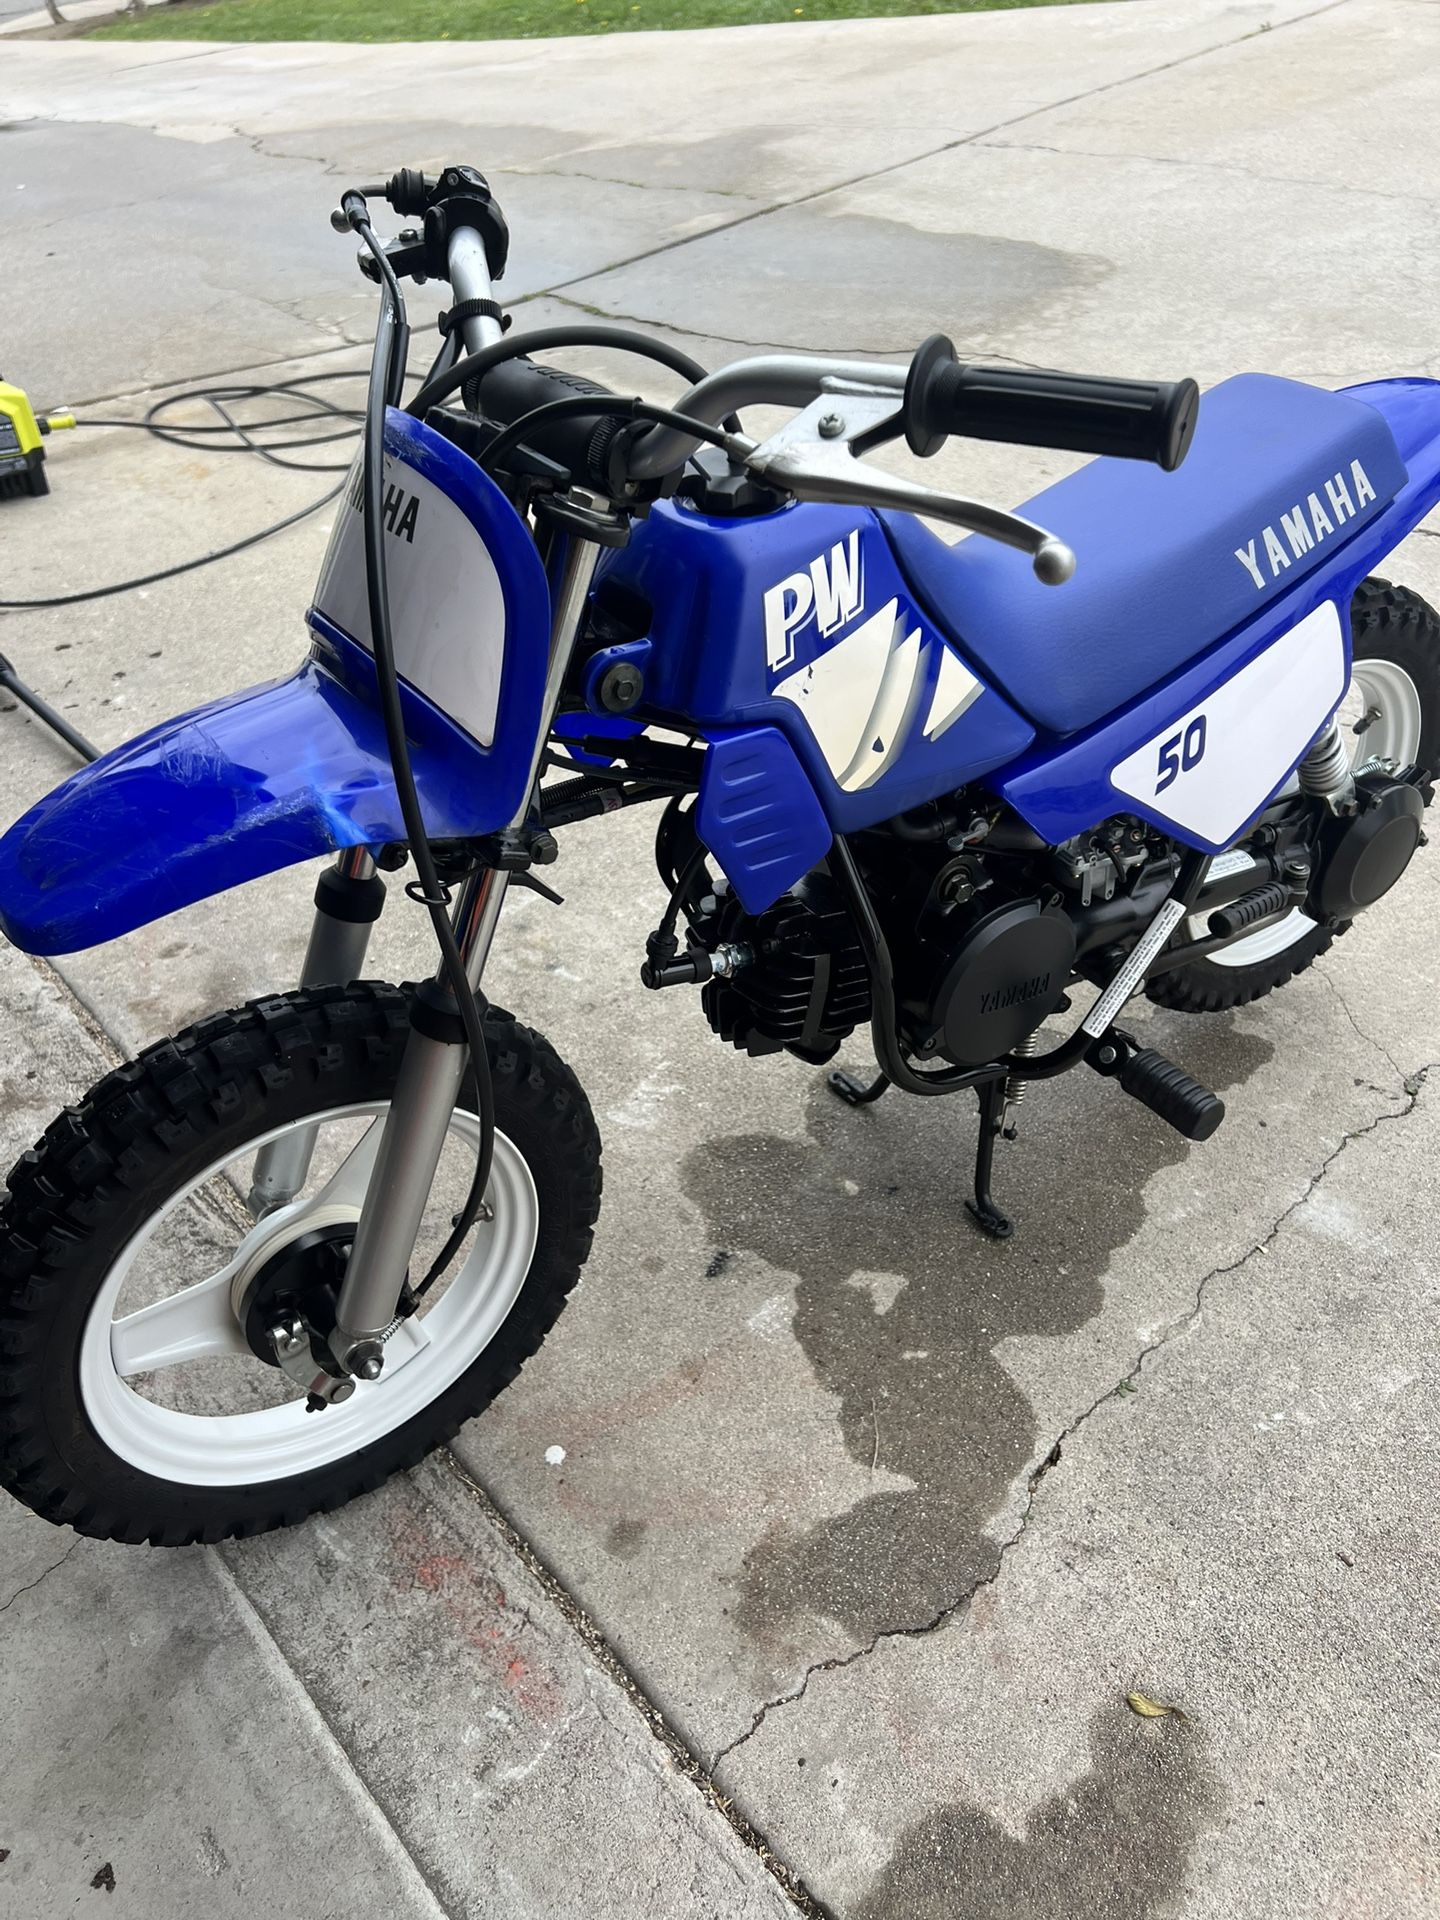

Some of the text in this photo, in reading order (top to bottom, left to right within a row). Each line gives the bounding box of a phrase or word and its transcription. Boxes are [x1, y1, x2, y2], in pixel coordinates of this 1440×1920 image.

[1234, 458, 1377, 589] YAMAHA
[764, 528, 865, 673] PW
[1155, 714, 1207, 796] 50
[980, 972, 1050, 1014] YAMAHA
